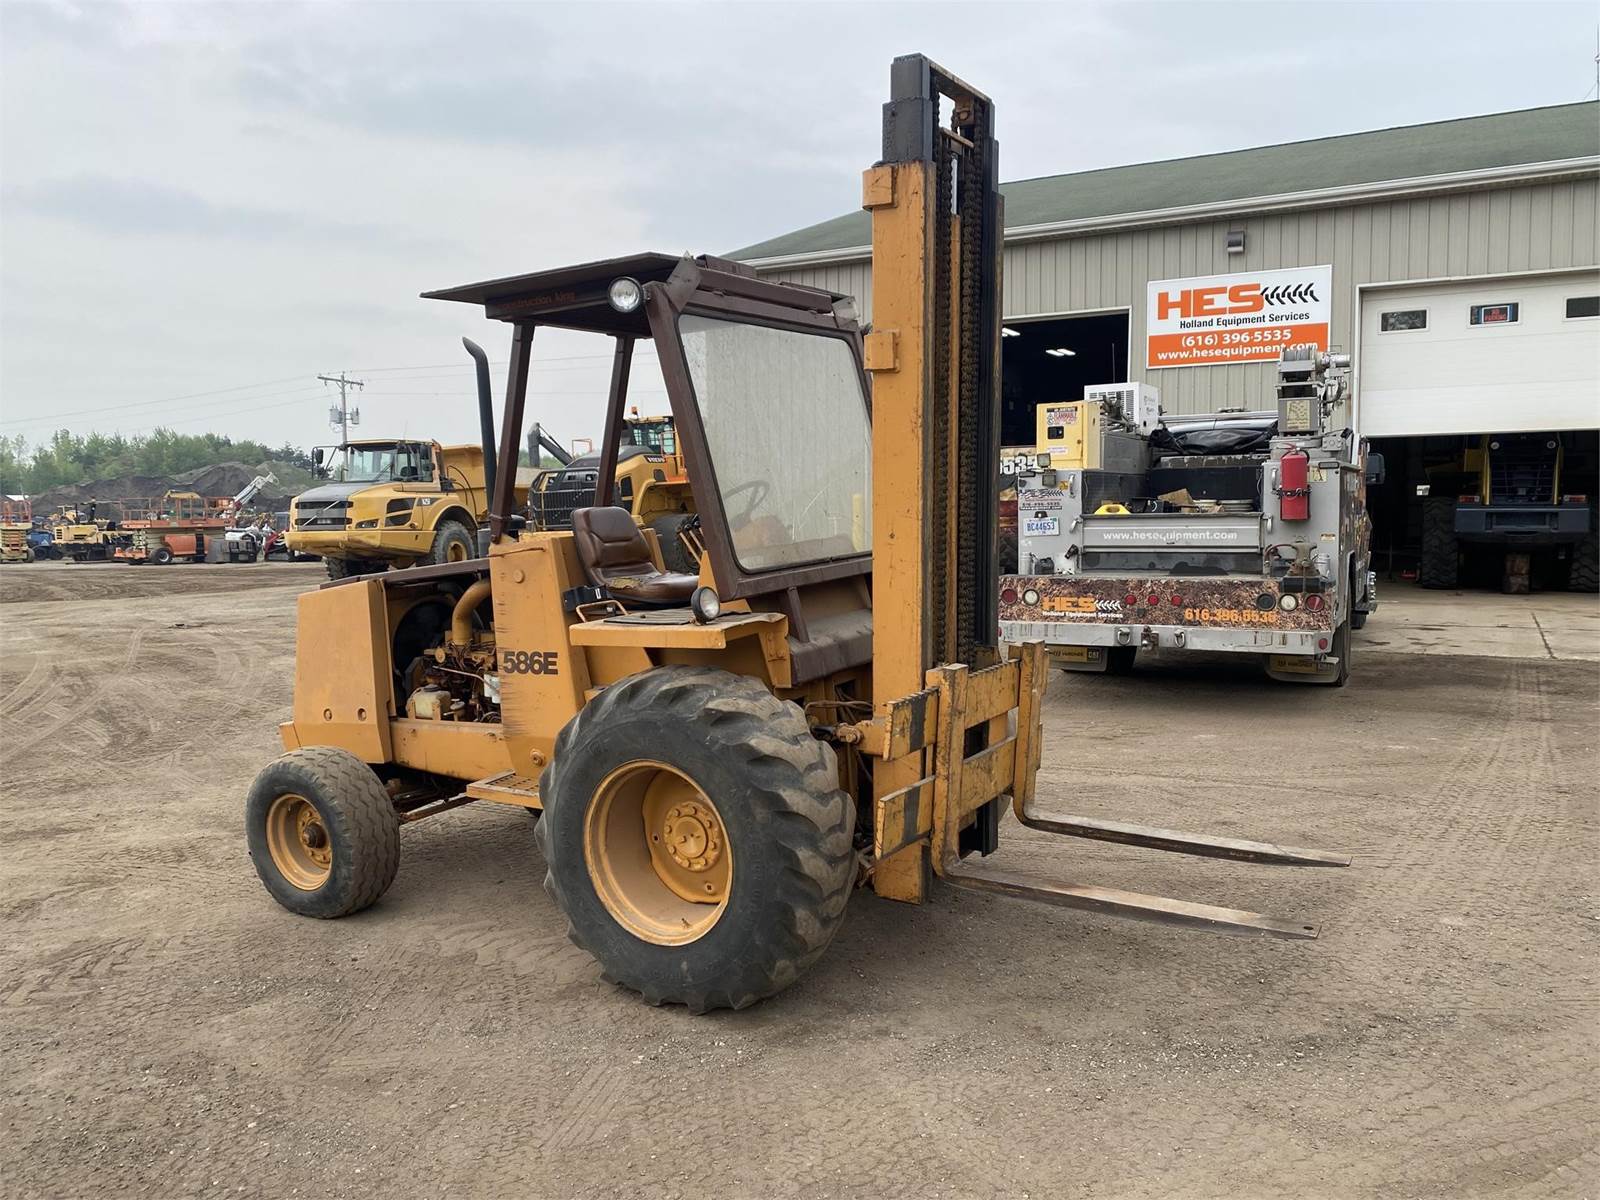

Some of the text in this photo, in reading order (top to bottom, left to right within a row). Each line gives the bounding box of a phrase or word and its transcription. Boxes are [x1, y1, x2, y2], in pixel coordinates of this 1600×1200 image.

[1157, 283, 1264, 320] HES
[1180, 311, 1310, 329] Holland Equipment Services
[1181, 333, 1218, 347] (616)
[1042, 596, 1096, 612] HES
[503, 650, 559, 675] 586E
